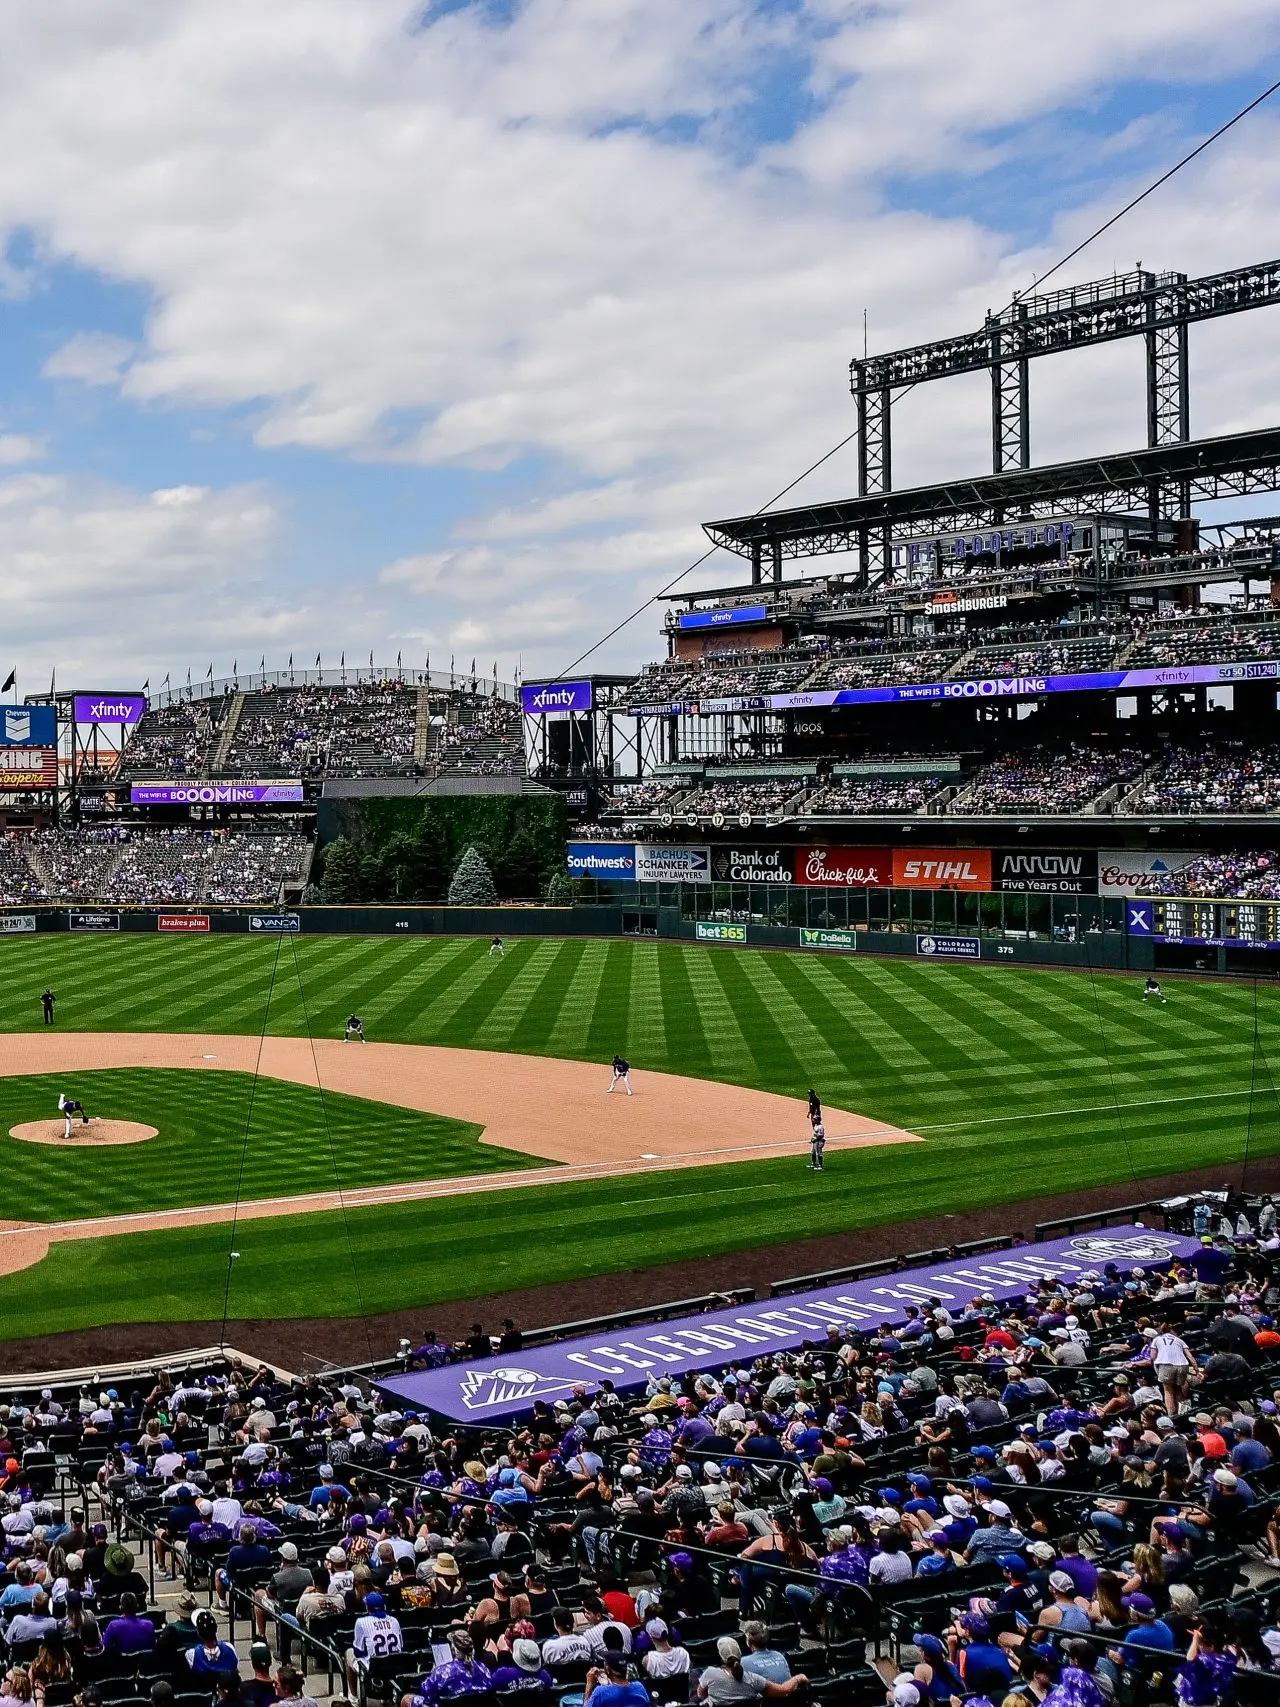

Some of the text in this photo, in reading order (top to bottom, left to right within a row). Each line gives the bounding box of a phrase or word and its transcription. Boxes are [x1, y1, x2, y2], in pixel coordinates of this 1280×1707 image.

[894, 522, 1074, 565] THE ROOFTOP
[711, 613, 732, 622] xfinity
[1155, 671, 1189, 682] xfinity
[944, 679, 1045, 696] BOOOMING
[533, 689, 575, 706] xfinity
[789, 695, 813, 704] xfinity
[91, 702, 132, 718] xfinity
[170, 788, 254, 801] BOOOMING
[273, 790, 295, 798] xfinity
[564, 793, 586, 801] LATTE
[662, 815, 671, 824] 42
[715, 815, 722, 824] 17
[741, 816, 749, 824] 33
[650, 850, 689, 860] BACHUS
[731, 851, 780, 866] Bank of
[567, 856, 624, 869] Southwest
[638, 860, 689, 870] SCHANKER
[644, 870, 702, 880] INJURY LAWYERS
[731, 866, 792, 882] Colorado
[904, 861, 978, 880] STIHL
[1002, 879, 1081, 891] Five Years Out
[1166, 911, 1181, 919] MIL
[1239, 906, 1253, 914] ARI
[161, 918, 188, 926] brakes
[1130, 910, 1149, 930] X
[698, 924, 744, 939] bet365
[1169, 929, 1180, 937] PIT
[1240, 924, 1256, 932] LAD
[821, 933, 851, 943] DaBella
[1239, 932, 1252, 940] STL
[566, 1256, 1082, 1375] CELEBRATING 30 YEARS
[1162, 1338, 1174, 1346] 17
[373, 1621, 391, 1630] SOTO
[373, 1634, 398, 1656] 22
